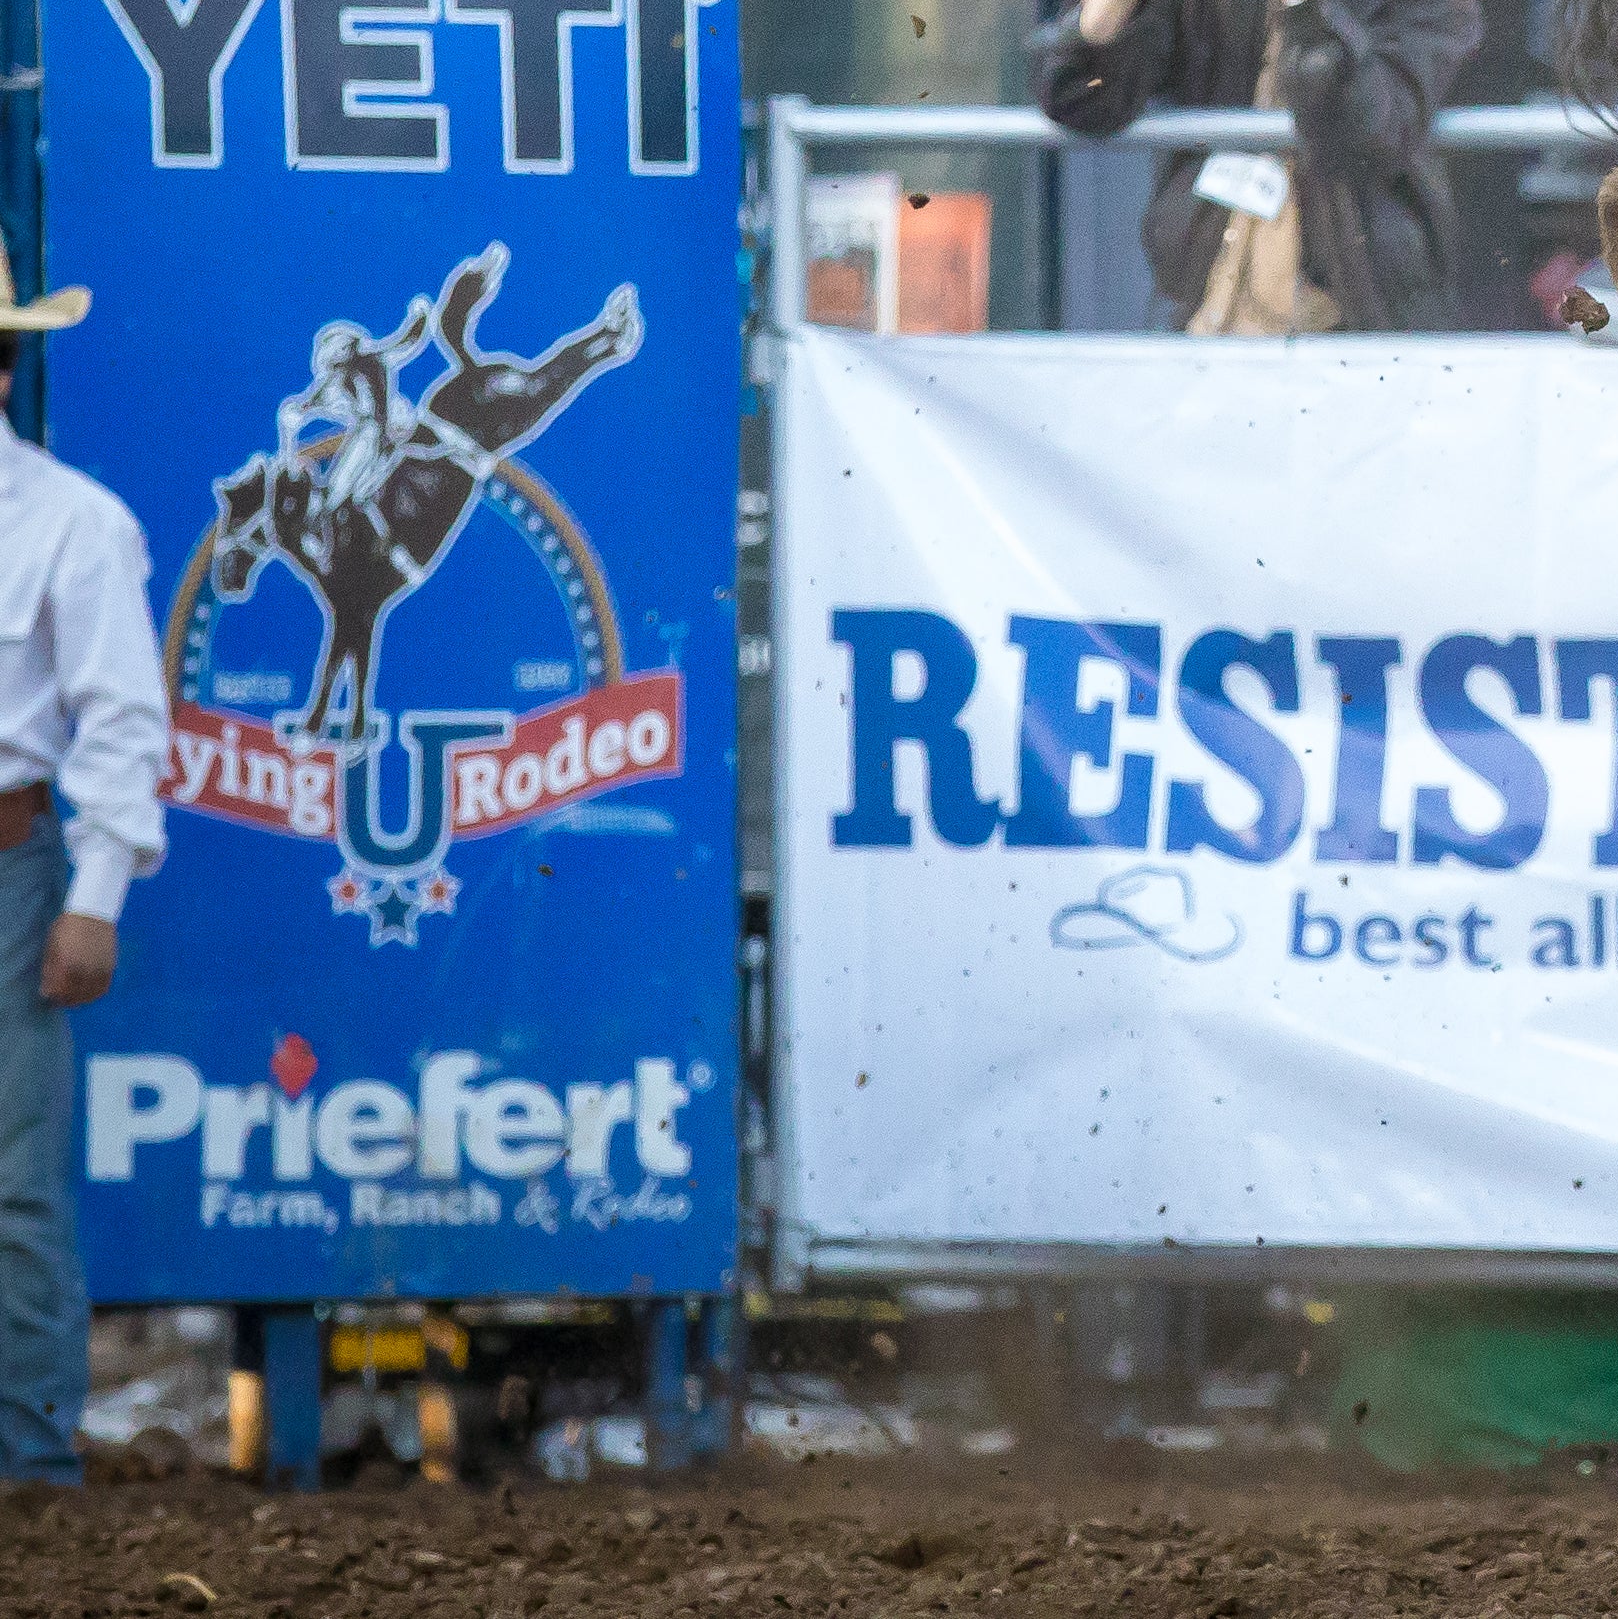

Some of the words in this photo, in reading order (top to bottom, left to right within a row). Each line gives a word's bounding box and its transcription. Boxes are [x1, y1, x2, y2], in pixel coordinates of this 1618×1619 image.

[168, 720, 335, 837] ying
[272, 708, 517, 875] U
[452, 709, 673, 828] Rodeo
[1290, 890, 1495, 969] best
[85, 1032, 693, 1181] Priefert
[201, 1181, 338, 1235] Farm,
[349, 1181, 501, 1227] Ranch
